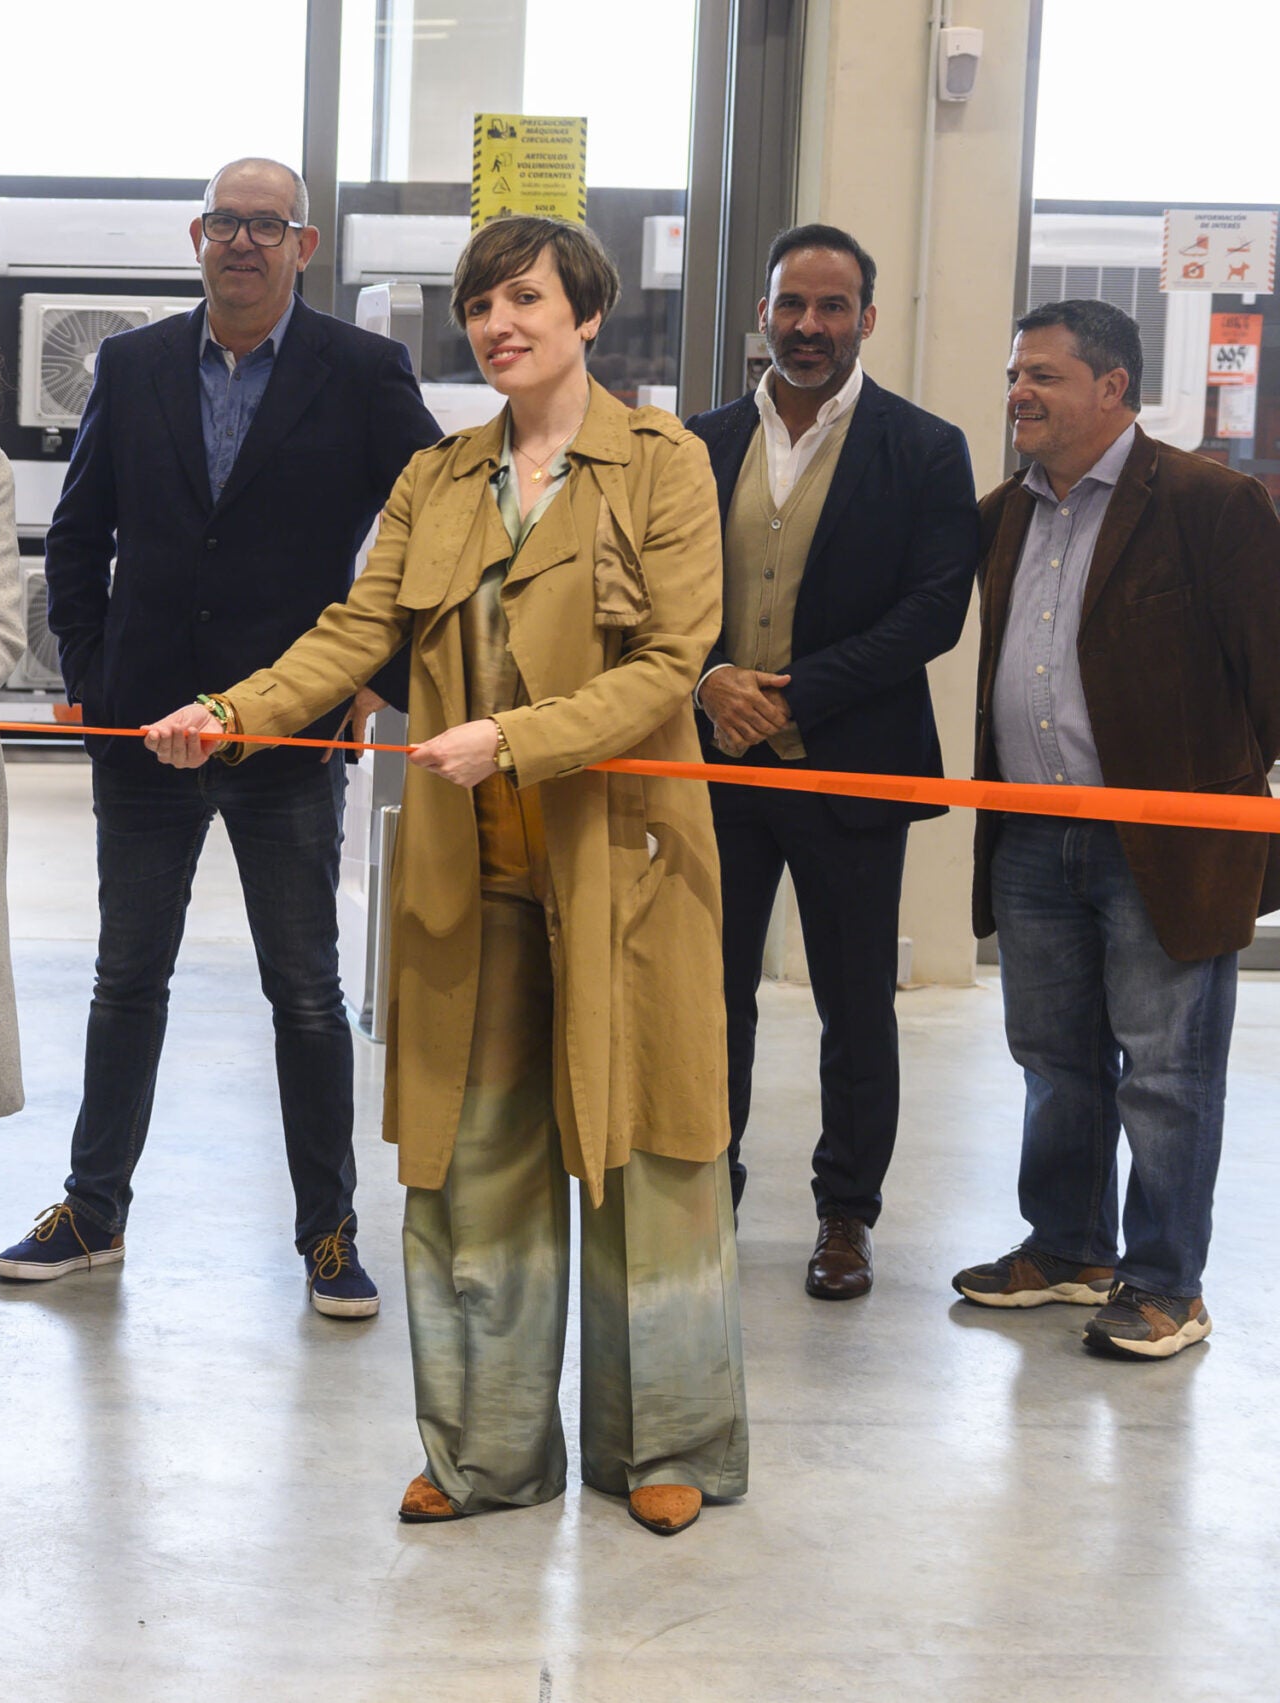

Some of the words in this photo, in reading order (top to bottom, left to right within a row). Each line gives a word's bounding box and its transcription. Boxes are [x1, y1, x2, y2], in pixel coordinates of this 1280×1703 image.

[521, 136, 573, 144] CIRCULANDO
[517, 162, 575, 170] VOLUMINOSOS
[528, 172, 572, 180] CORTANTES
